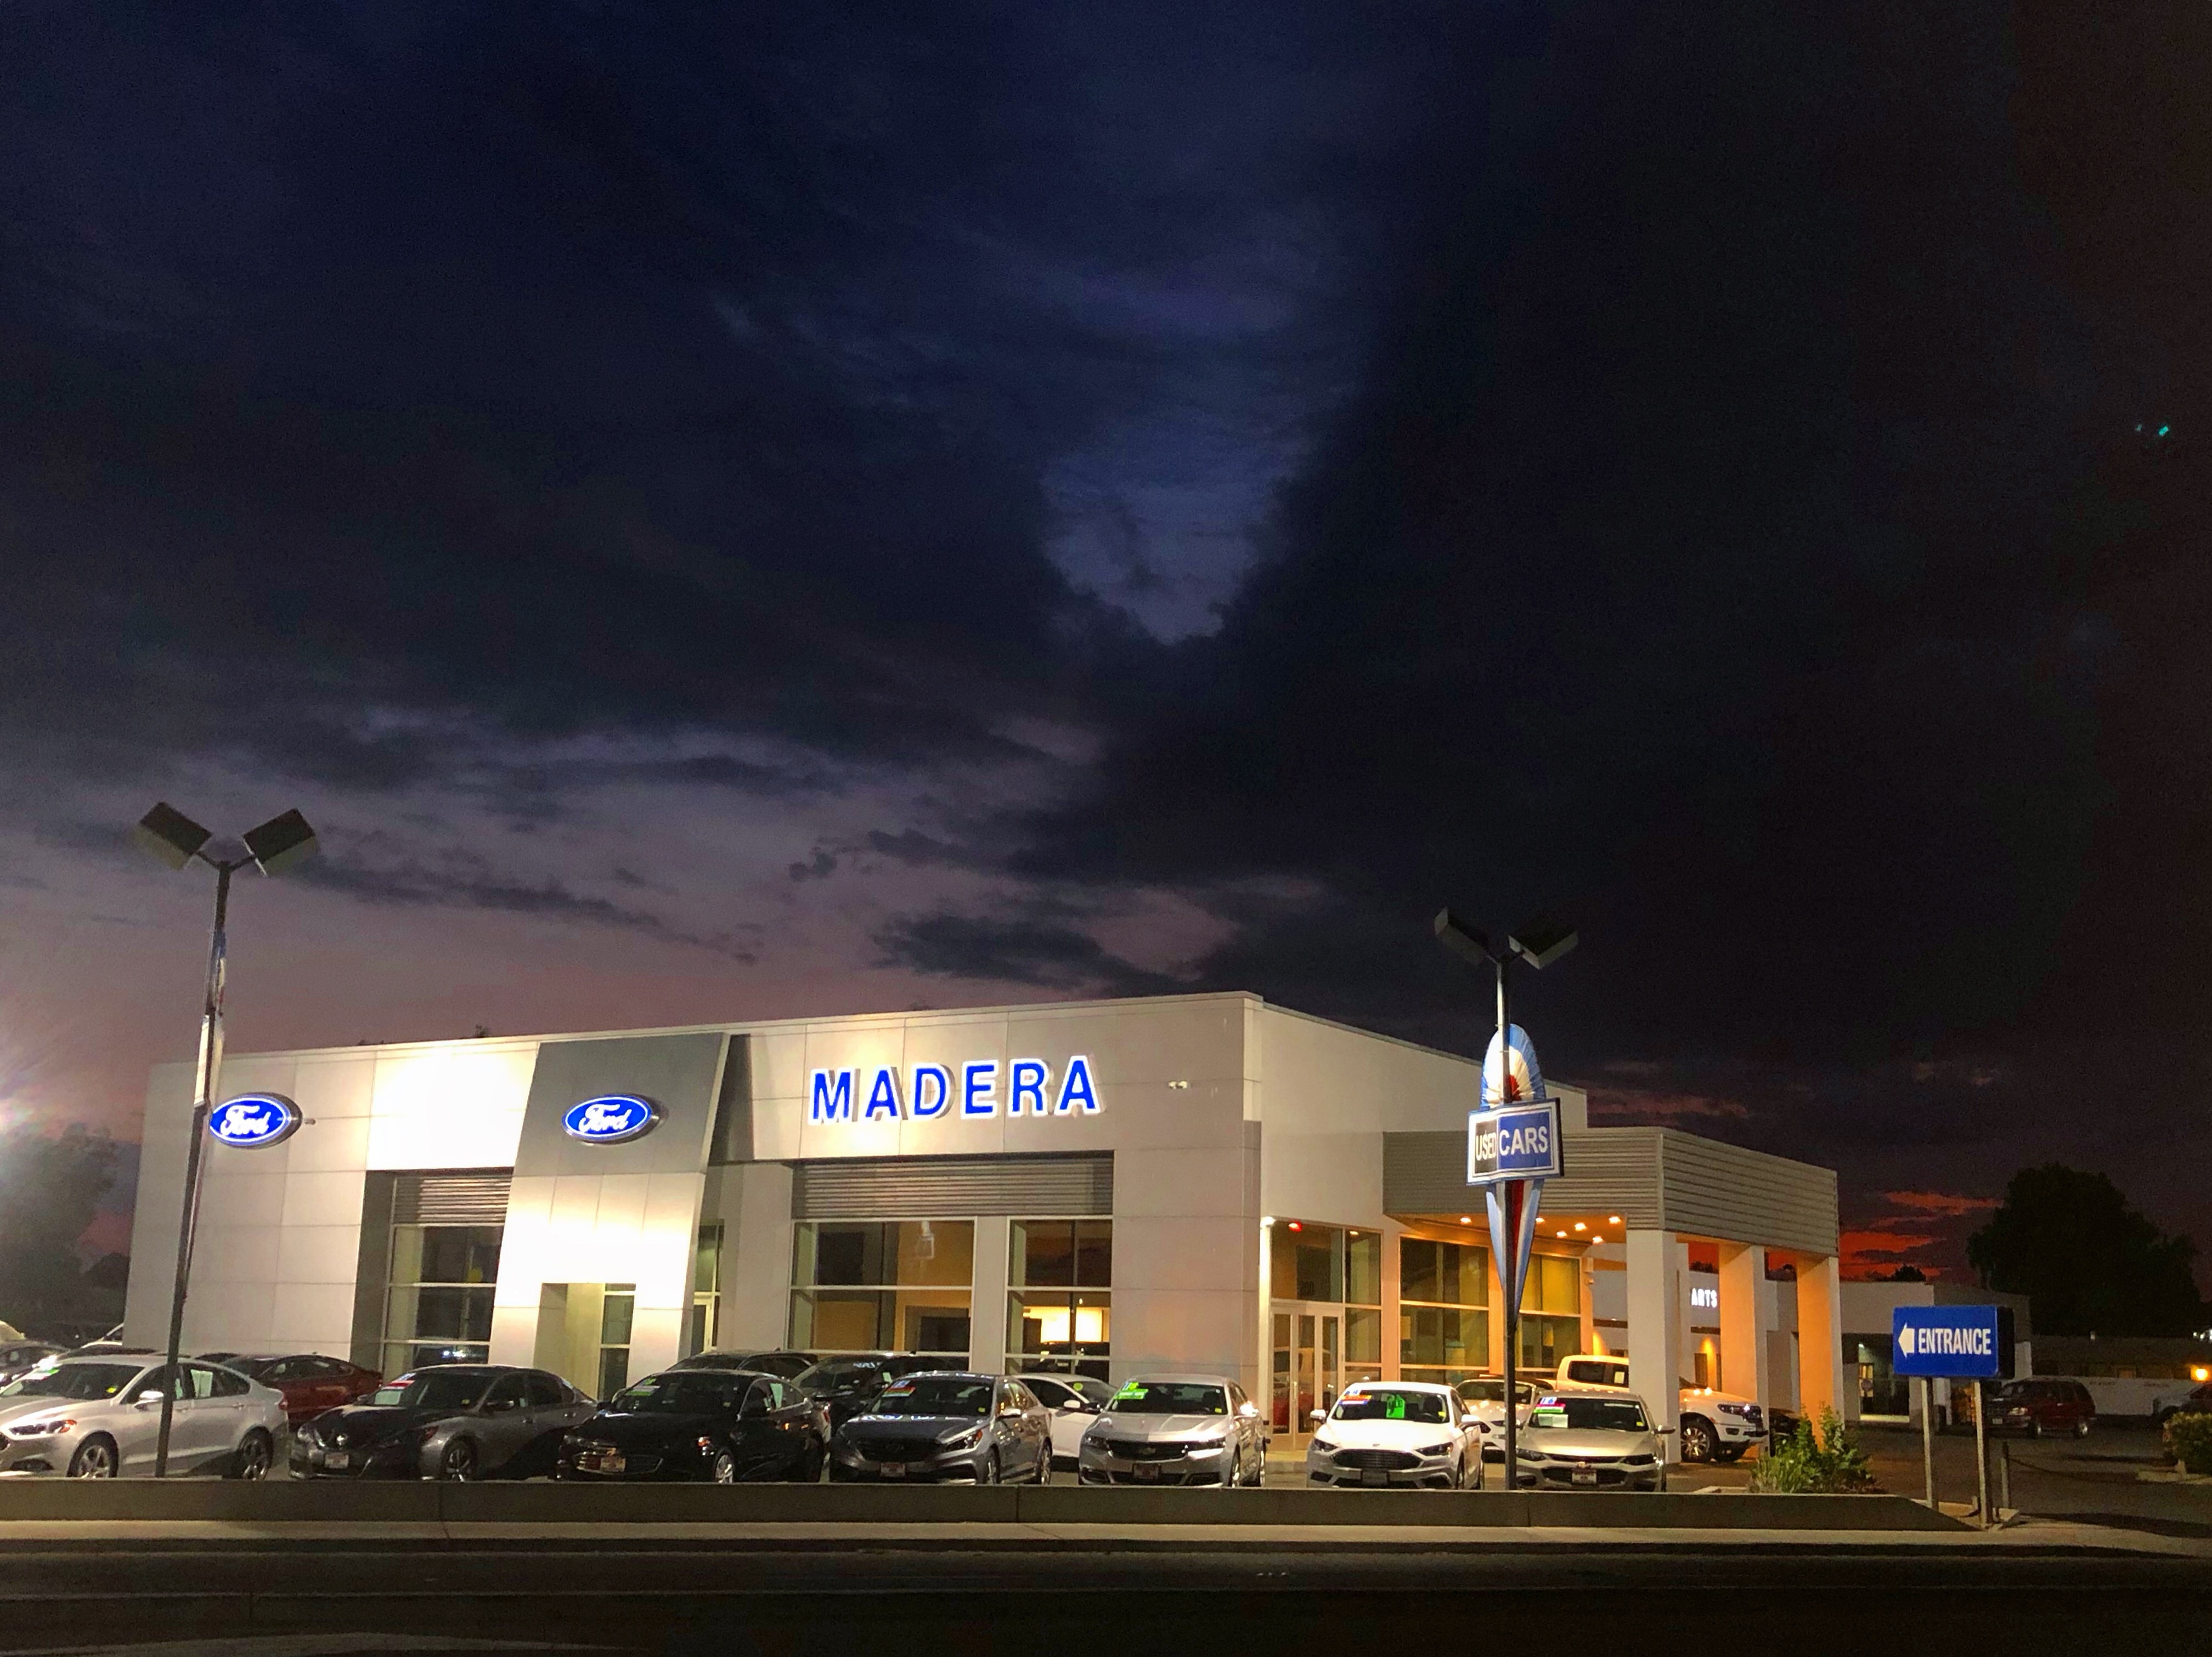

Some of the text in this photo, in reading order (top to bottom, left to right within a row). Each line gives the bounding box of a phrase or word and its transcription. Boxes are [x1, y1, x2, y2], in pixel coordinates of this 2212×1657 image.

[809, 1055, 1101, 1124] MADERA
[221, 1105, 271, 1135] Ford
[578, 1104, 632, 1133] Ford
[1475, 1126, 1549, 1161] USED CARS
[1691, 1288, 1717, 1308] ARTS
[1918, 1328, 1991, 1355] ENTRANCE
